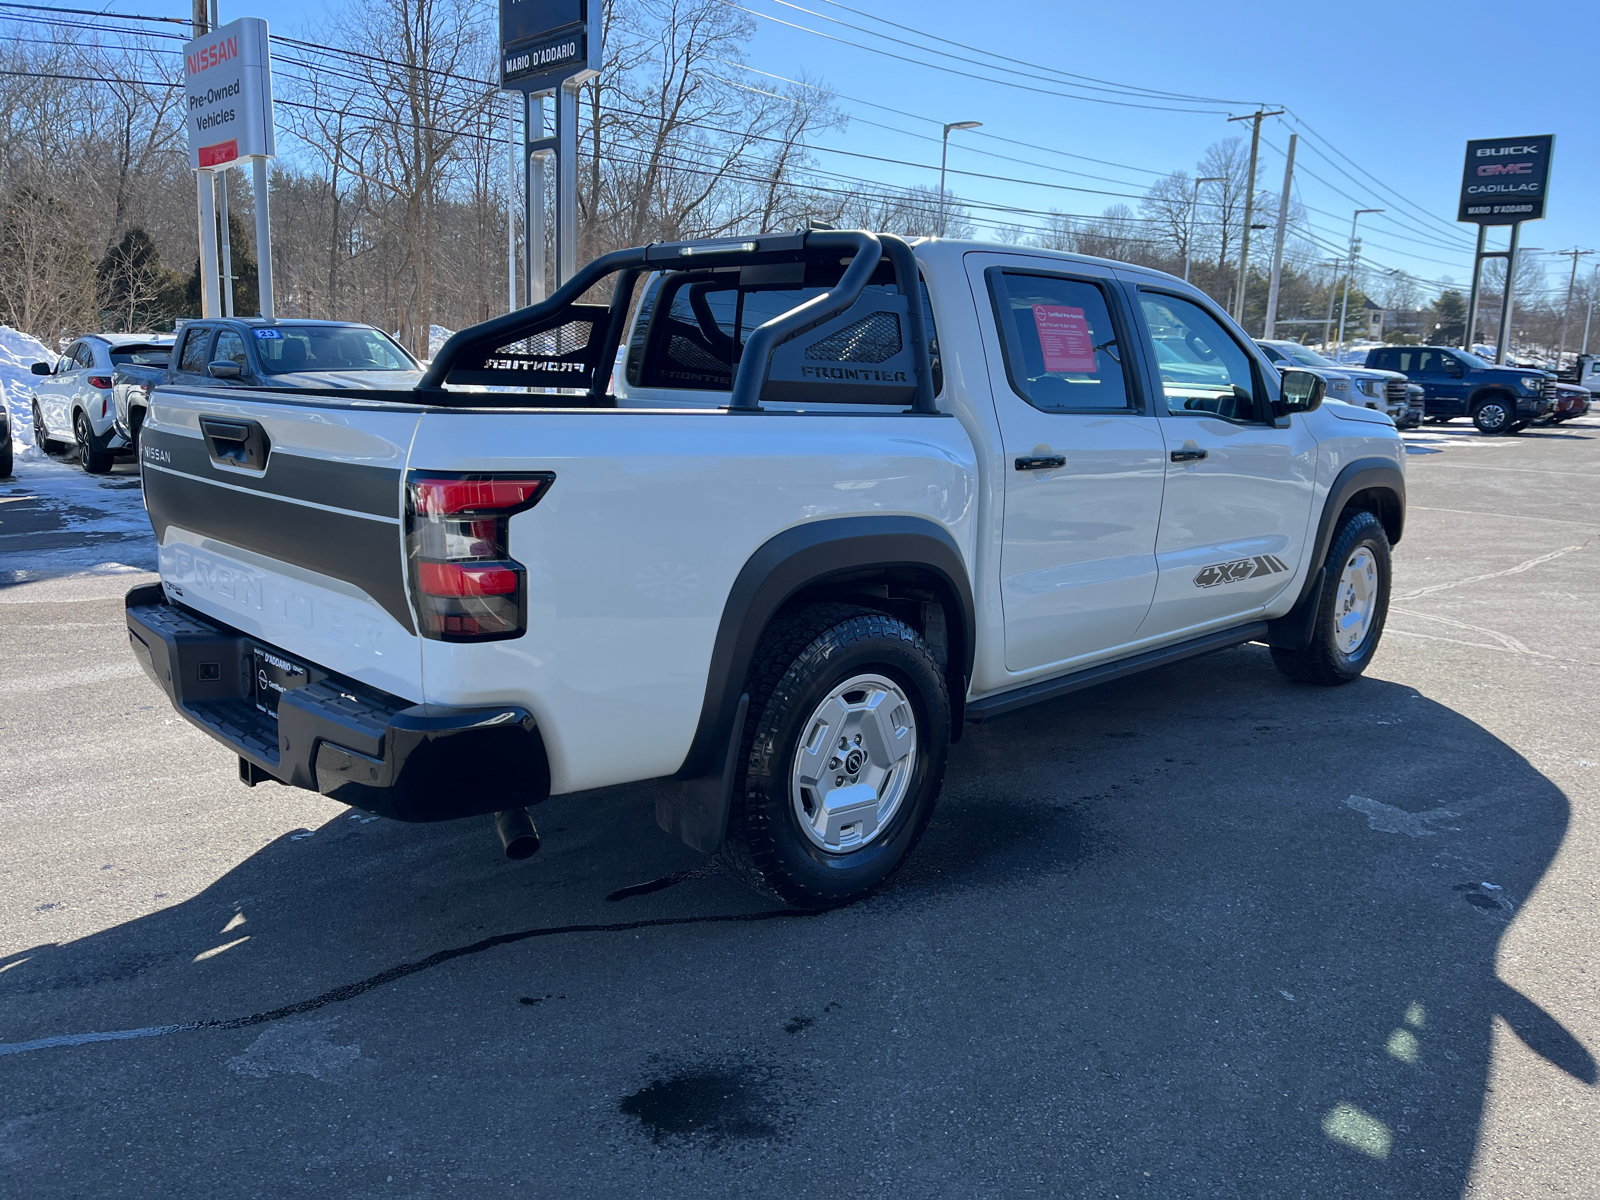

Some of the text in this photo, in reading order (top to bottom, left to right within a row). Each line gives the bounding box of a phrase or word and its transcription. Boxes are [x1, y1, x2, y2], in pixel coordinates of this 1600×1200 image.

[187, 35, 238, 76] NISSAN
[506, 42, 575, 73] MARIO D'ADDARIO
[190, 79, 240, 110] Pre-Owned
[197, 108, 235, 131] Vehicles
[1476, 145, 1539, 157] BUICK
[1477, 162, 1533, 176] GMC
[1467, 183, 1539, 194] CADILLAC
[1467, 204, 1533, 215] MARIO D'ADDARIO
[659, 369, 731, 384] FRONTIE
[801, 365, 907, 382] FRONTIER
[144, 445, 171, 464] NISSAN
[265, 653, 291, 671] D'ADDARIO
